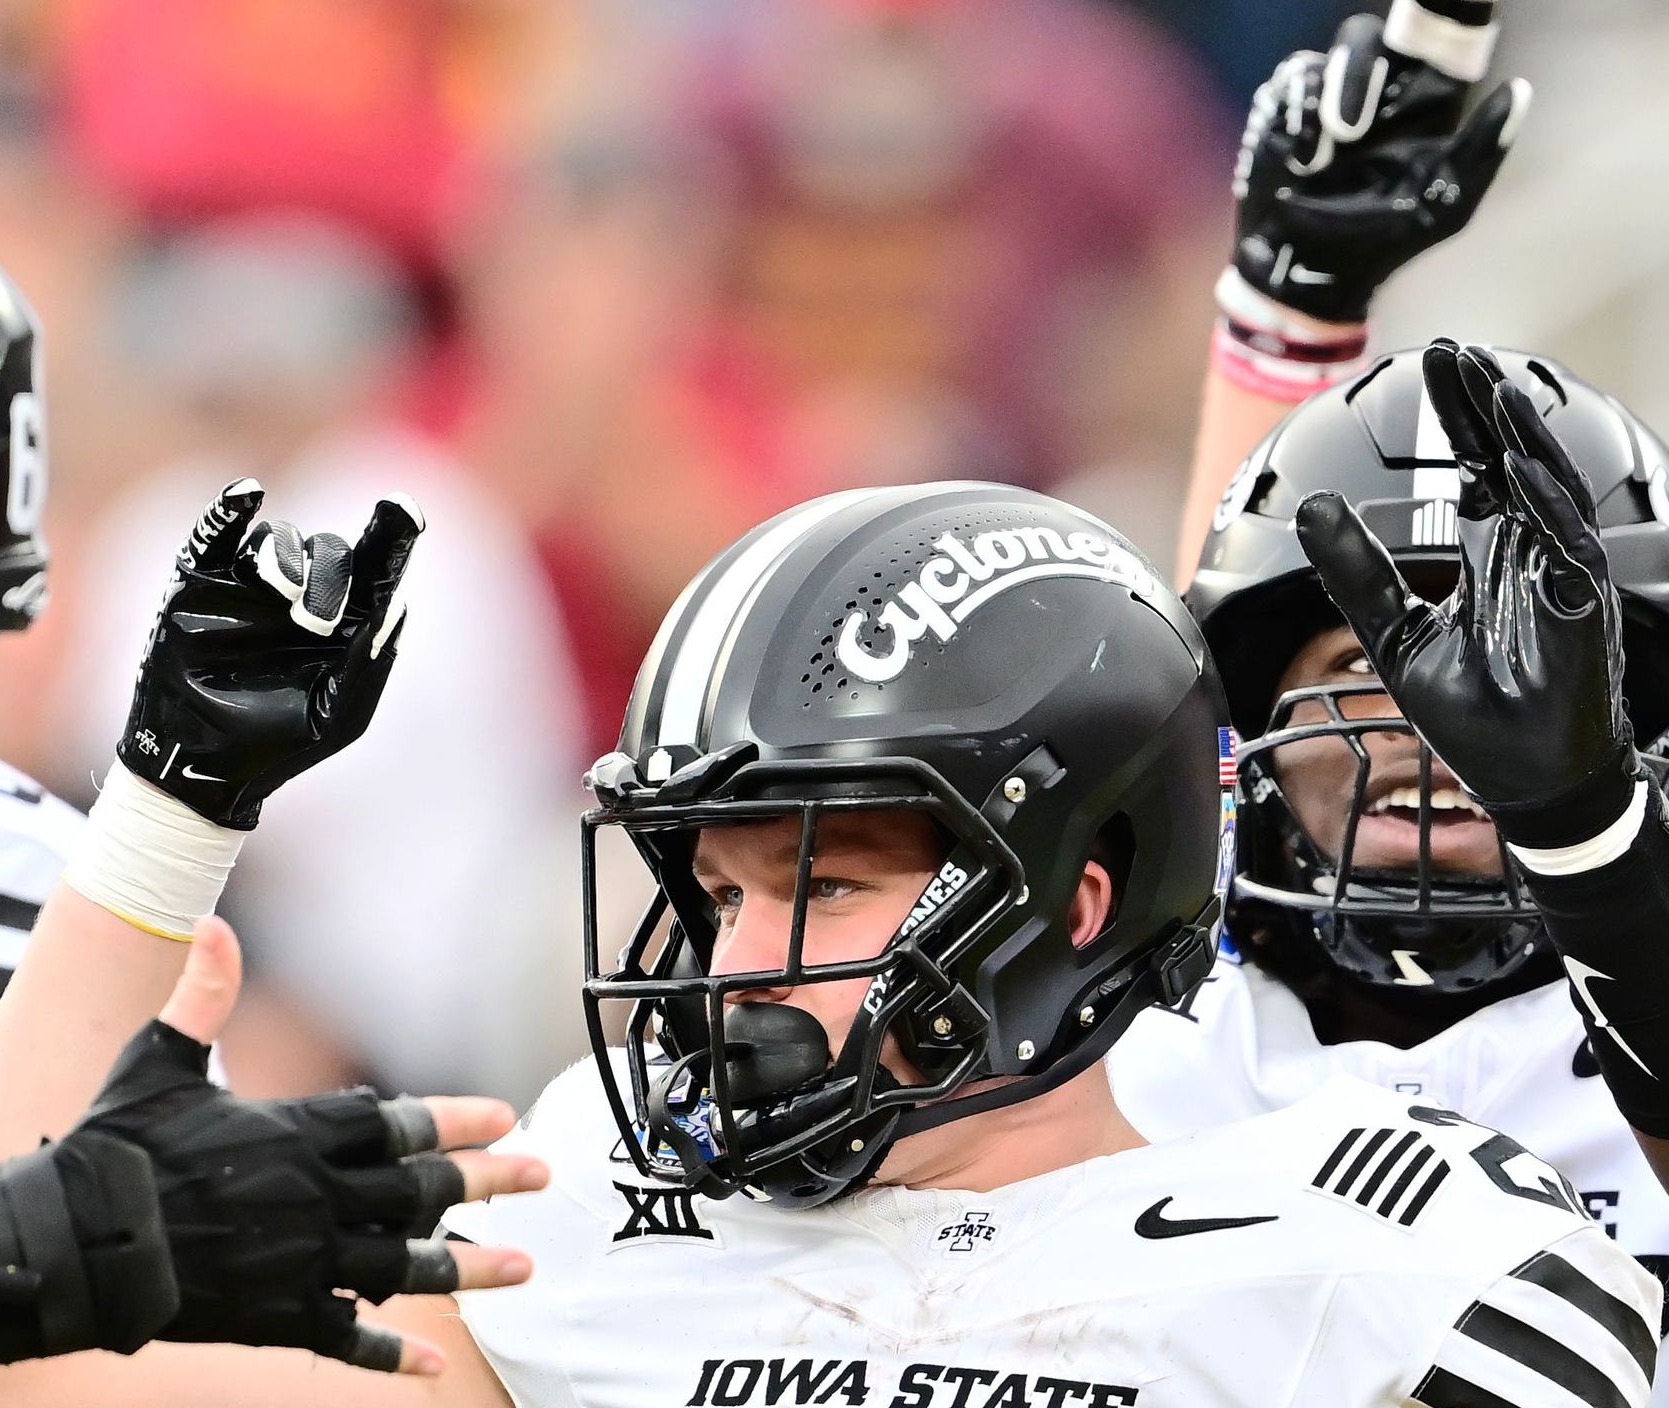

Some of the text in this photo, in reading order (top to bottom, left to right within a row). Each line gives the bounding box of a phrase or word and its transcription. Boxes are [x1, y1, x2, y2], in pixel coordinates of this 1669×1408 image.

[837, 526, 1156, 683] Cyclones
[937, 1219, 997, 1245] STATE
[685, 1357, 869, 1408] IOWA
